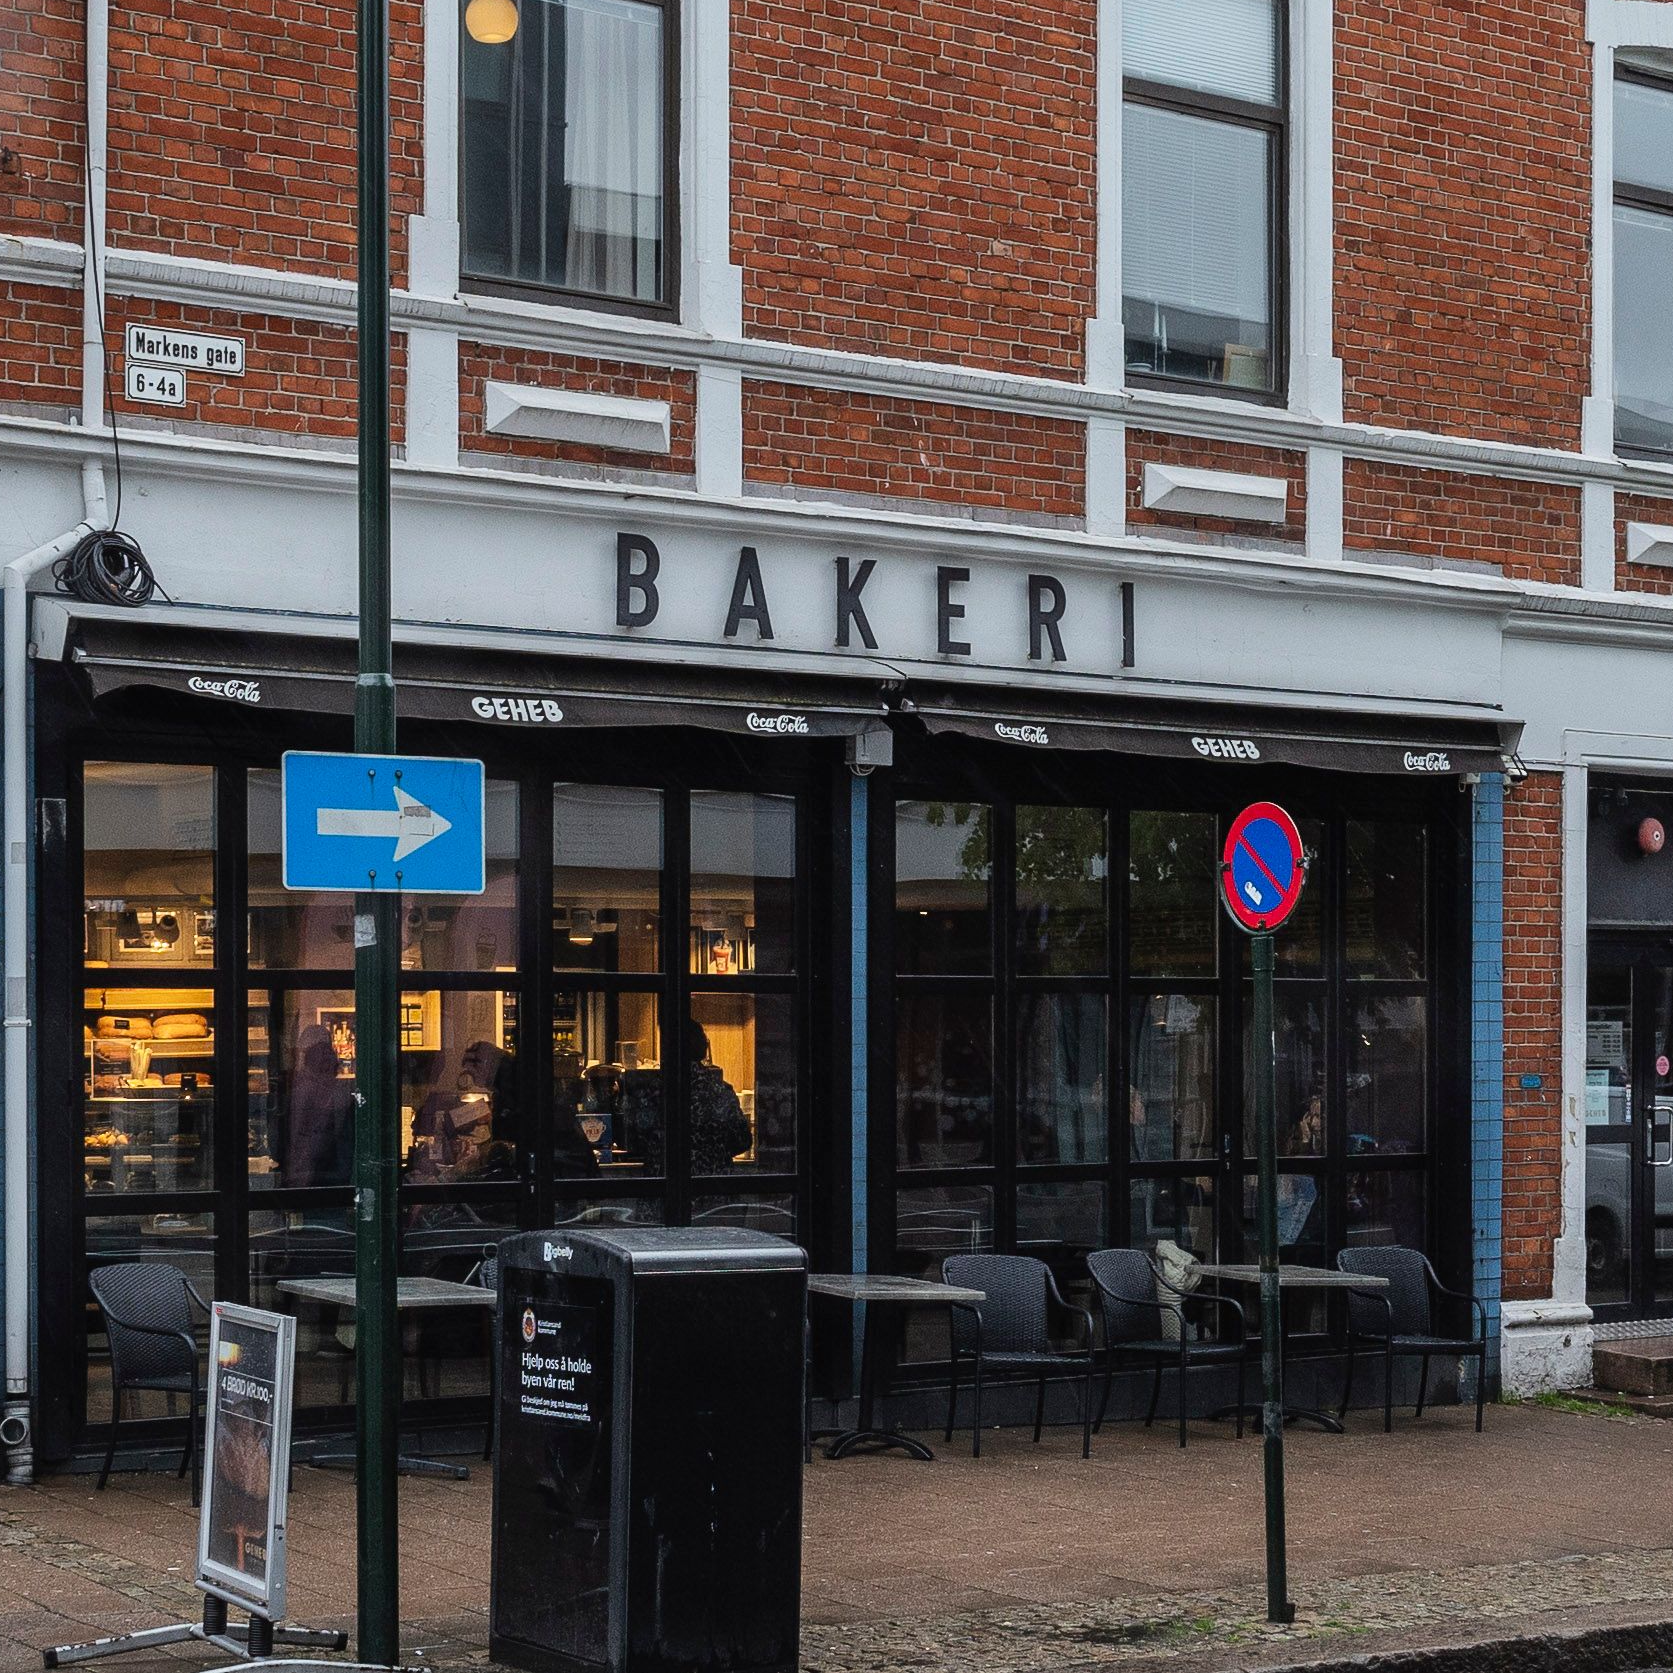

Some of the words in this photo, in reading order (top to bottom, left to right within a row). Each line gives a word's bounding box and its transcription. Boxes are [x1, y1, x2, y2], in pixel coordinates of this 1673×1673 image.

[135, 331, 198, 360] Markens
[206, 346, 237, 367] gate
[136, 373, 176, 397] 6-4a
[615, 531, 1136, 669] BAKERI
[471, 696, 564, 722] GEHEB
[1190, 736, 1261, 760] GEHEB
[543, 1241, 574, 1262] Bigbelly
[521, 1352, 544, 1371] Hjelp
[545, 1358, 560, 1370] oss
[560, 1356, 566, 1371] å
[567, 1357, 592, 1374] holde
[221, 1376, 227, 1390] 4
[521, 1370, 542, 1388] byen
[542, 1373, 557, 1389] vår
[557, 1377, 575, 1391] ren!
